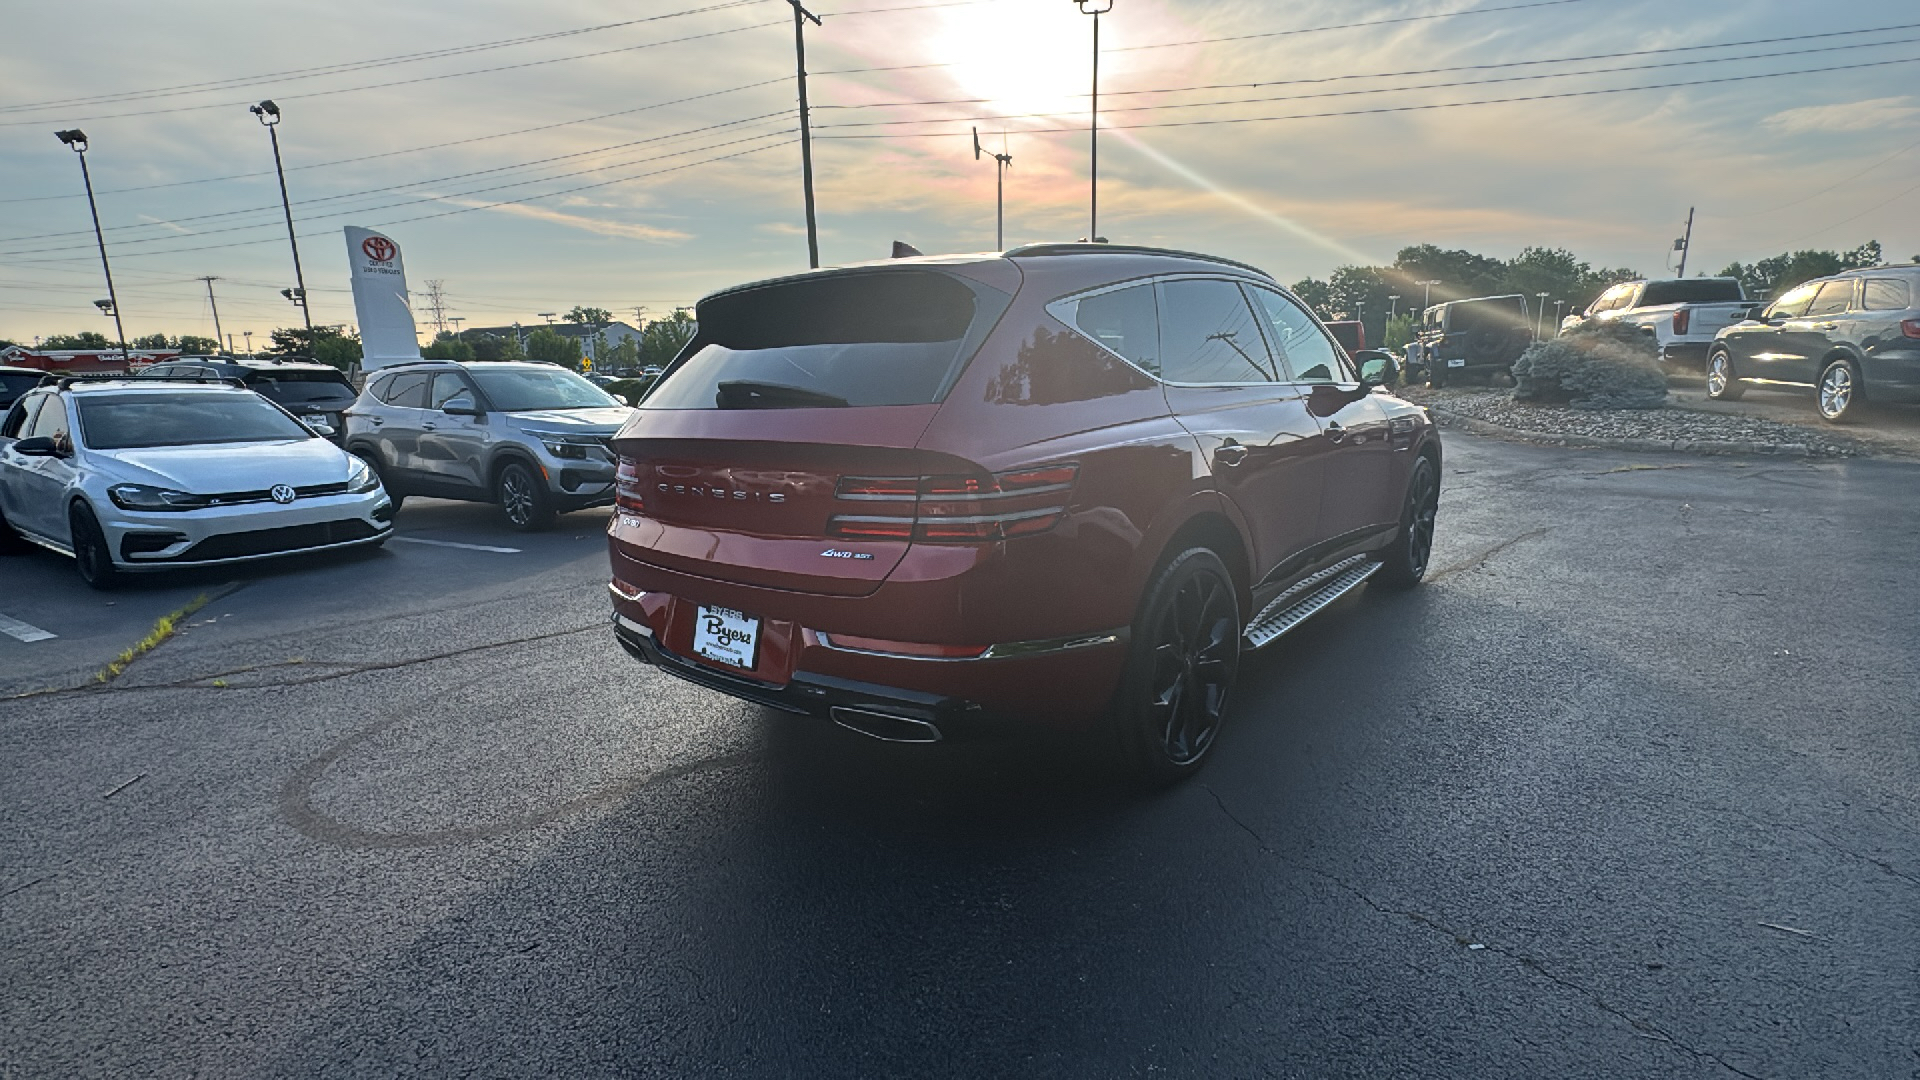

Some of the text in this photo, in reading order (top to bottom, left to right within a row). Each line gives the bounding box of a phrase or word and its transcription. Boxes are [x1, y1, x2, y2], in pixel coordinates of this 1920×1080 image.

[658, 483, 785, 503] GENESIS
[710, 605, 743, 620] BYERS
[702, 614, 752, 647] Byers
